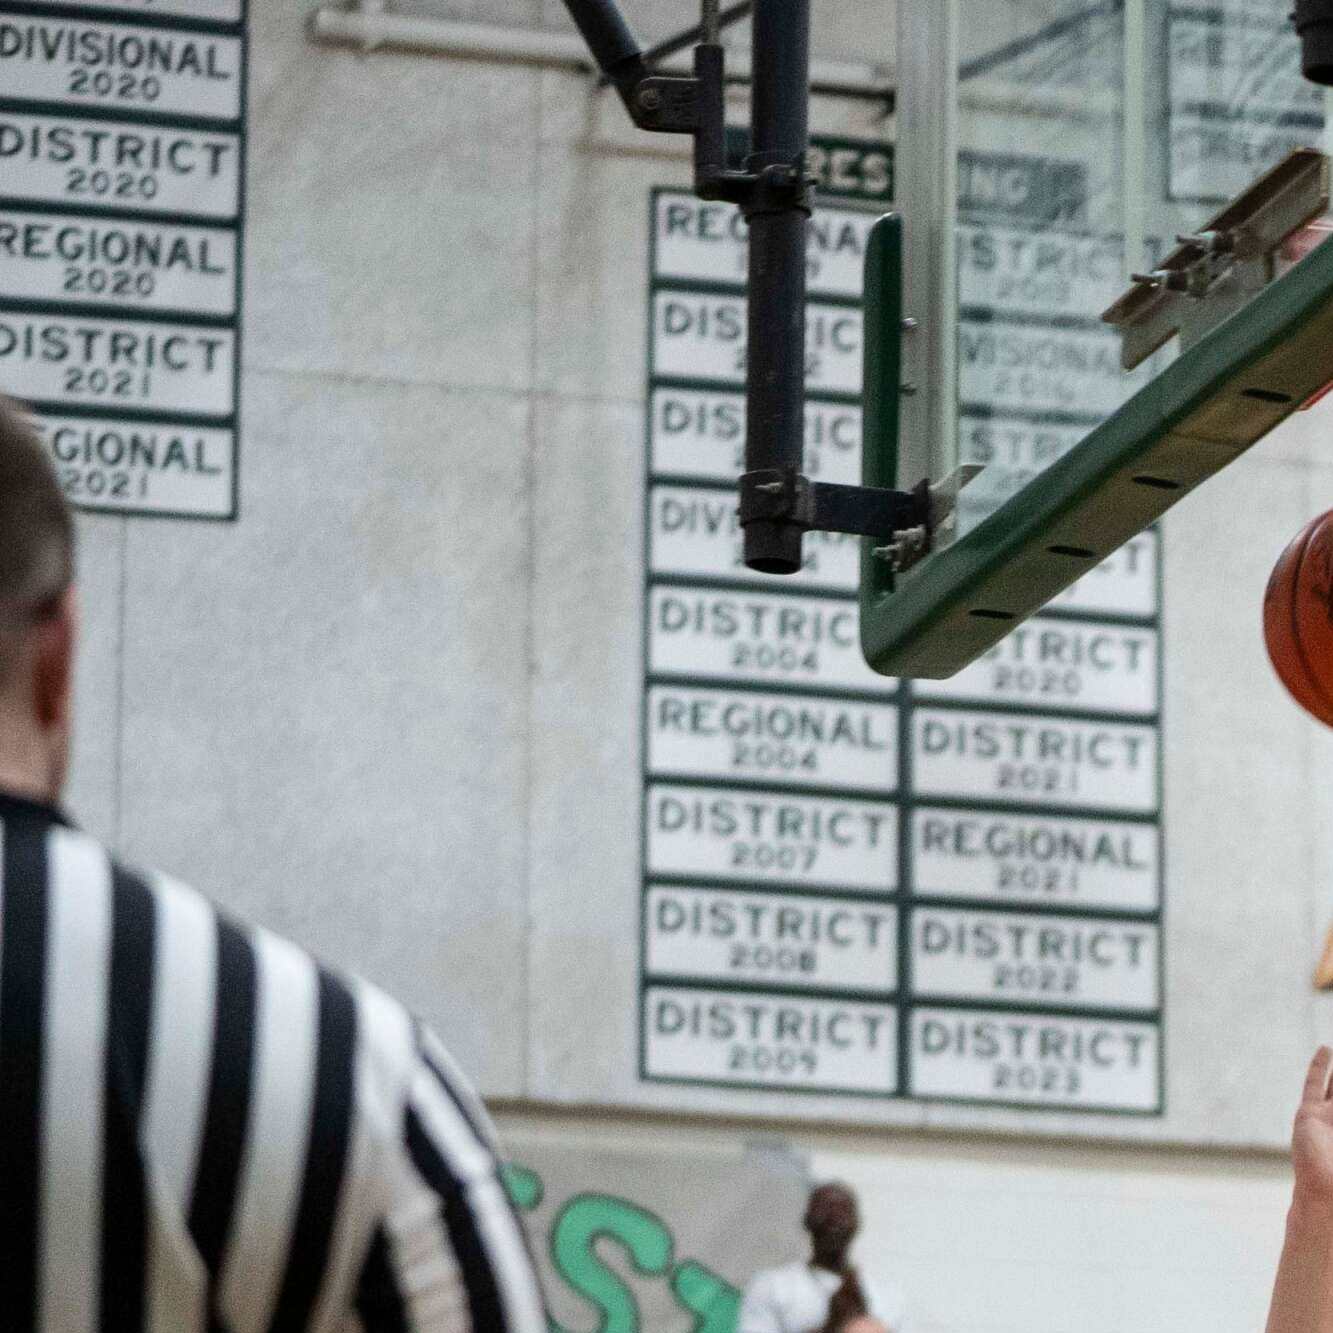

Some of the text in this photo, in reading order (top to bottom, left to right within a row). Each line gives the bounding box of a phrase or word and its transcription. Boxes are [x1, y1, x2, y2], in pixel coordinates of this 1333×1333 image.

[0, 23, 232, 80] DIVISIONAL
[68, 68, 162, 102] 2020
[66, 168, 159, 201] 2020
[62, 266, 157, 298] 2020
[62, 366, 152, 399] 2021
[660, 596, 855, 648] DISTRIC
[657, 697, 888, 751] REGIONAL
[922, 720, 1143, 772] DISTRICT
[657, 797, 887, 850] DISTRICT
[922, 817, 1147, 873] REGIONAL
[731, 840, 819, 874] 2007
[656, 898, 888, 950] DISTRICT
[921, 919, 1148, 970] DISTRICT
[655, 999, 887, 1053] DISTRICT
[921, 1018, 1147, 1069] DISTRICT
